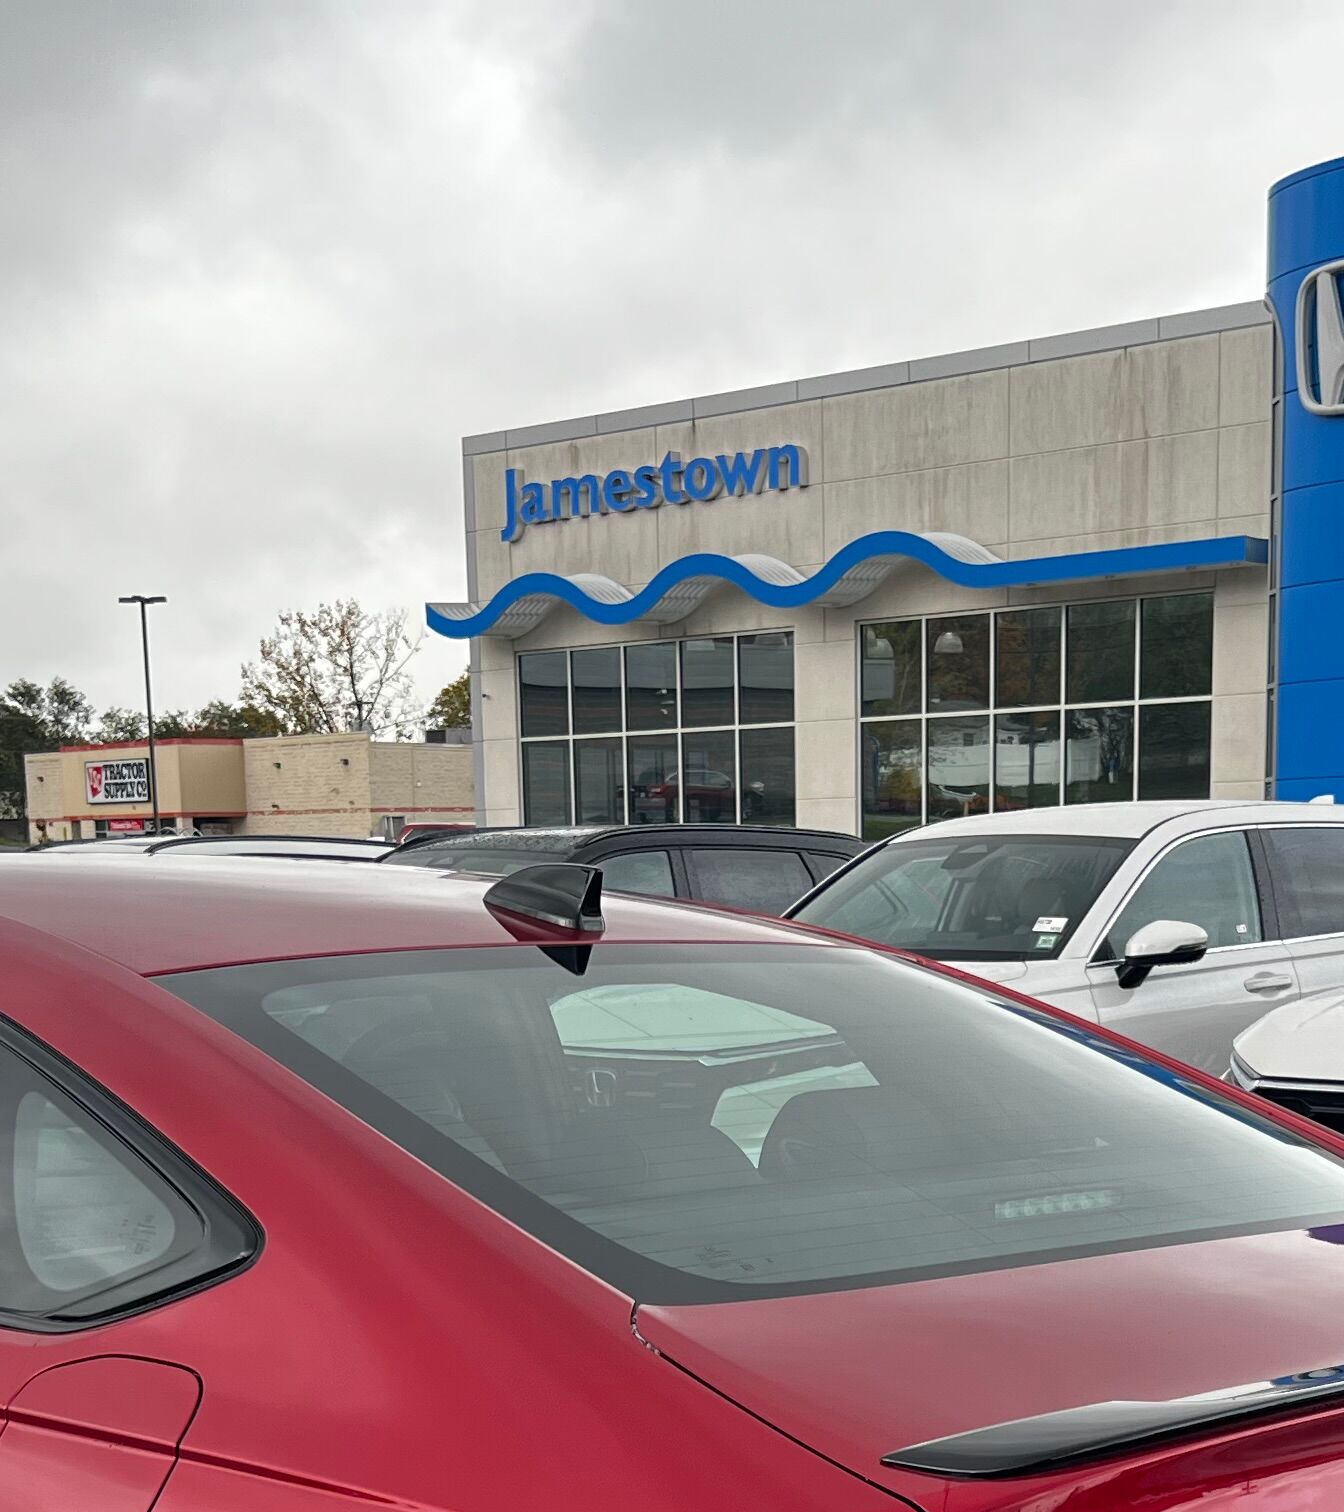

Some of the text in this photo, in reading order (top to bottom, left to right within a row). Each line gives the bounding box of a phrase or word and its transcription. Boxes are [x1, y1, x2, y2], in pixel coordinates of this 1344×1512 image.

[501, 444, 808, 542] Jamestown
[103, 763, 146, 780] TRACTOR
[104, 781, 136, 799] SUPPLY
